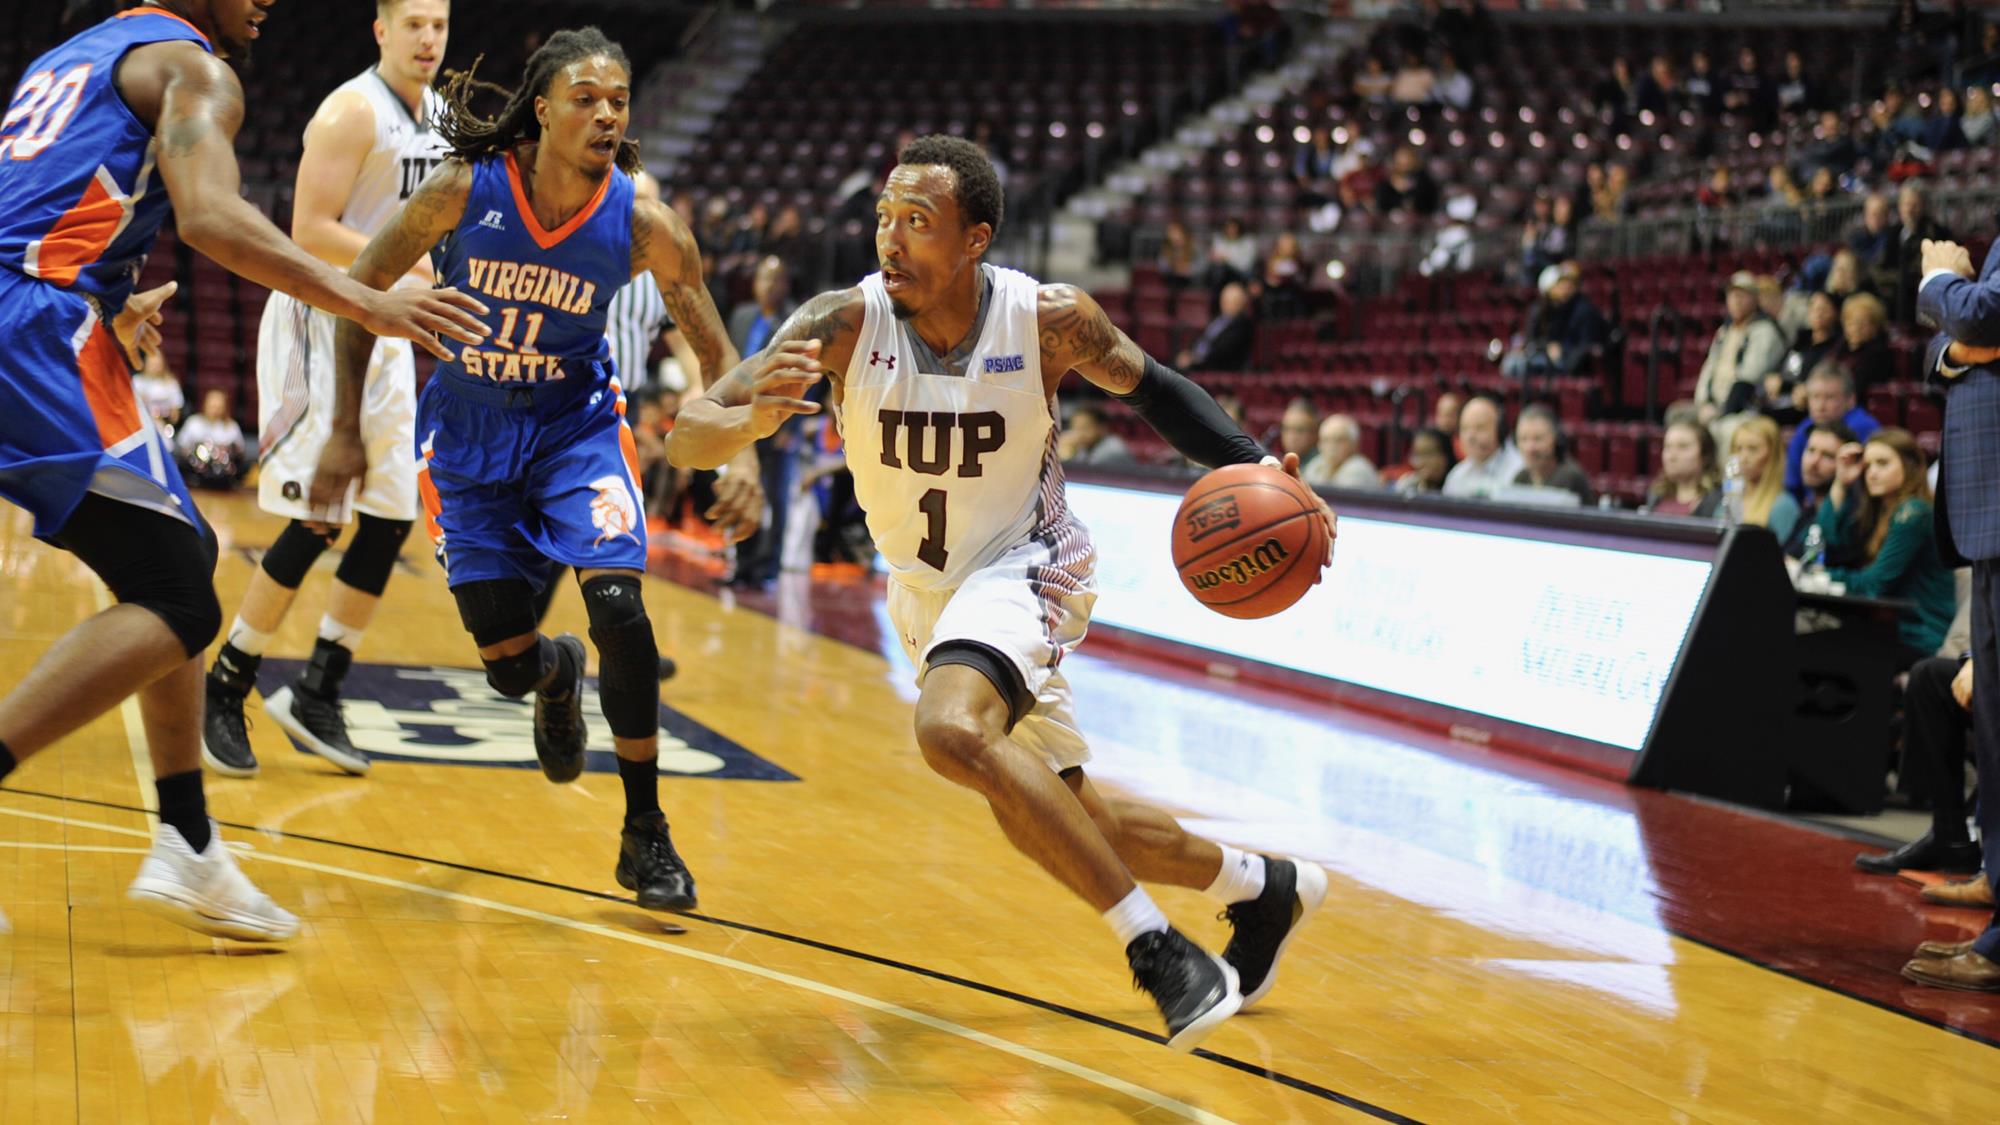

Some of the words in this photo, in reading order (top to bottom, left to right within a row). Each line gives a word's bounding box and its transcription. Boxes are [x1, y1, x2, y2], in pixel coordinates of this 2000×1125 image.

[0, 63, 94, 160] 20
[468, 256, 597, 315] VIRGINIA
[493, 307, 544, 355] 11
[461, 344, 566, 383] STATE
[984, 354, 1025, 374] PSAC
[878, 408, 1006, 478] IUP
[916, 487, 949, 573] 1
[1186, 502, 1240, 538] PSAC
[1189, 538, 1289, 590] Wilson
